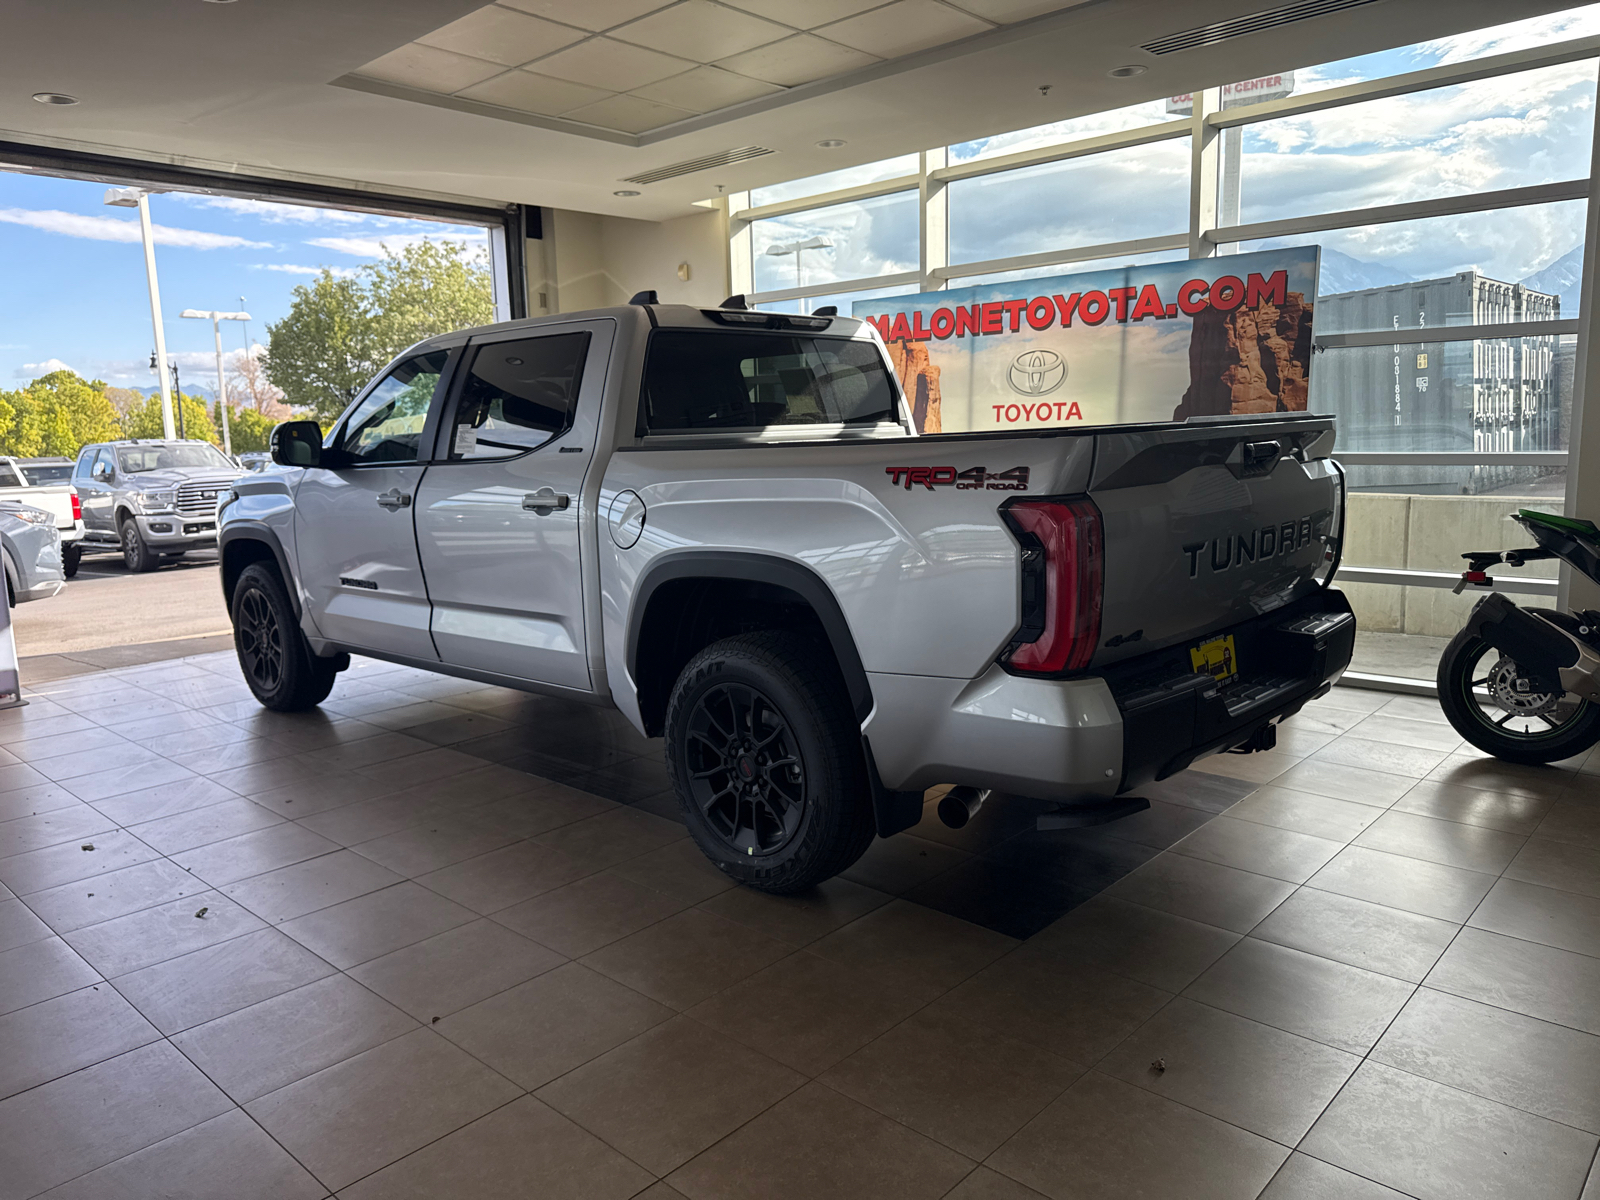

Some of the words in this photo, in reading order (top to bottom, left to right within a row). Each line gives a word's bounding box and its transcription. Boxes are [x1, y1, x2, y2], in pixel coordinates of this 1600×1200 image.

[1234, 75, 1282, 93] CENTER
[866, 270, 1288, 344] MALONETOYOTA.COM
[992, 401, 1083, 423] TOYOTA
[885, 466, 957, 492] TRD
[986, 483, 1028, 491] ROAD
[1182, 515, 1314, 580] TUNDRA
